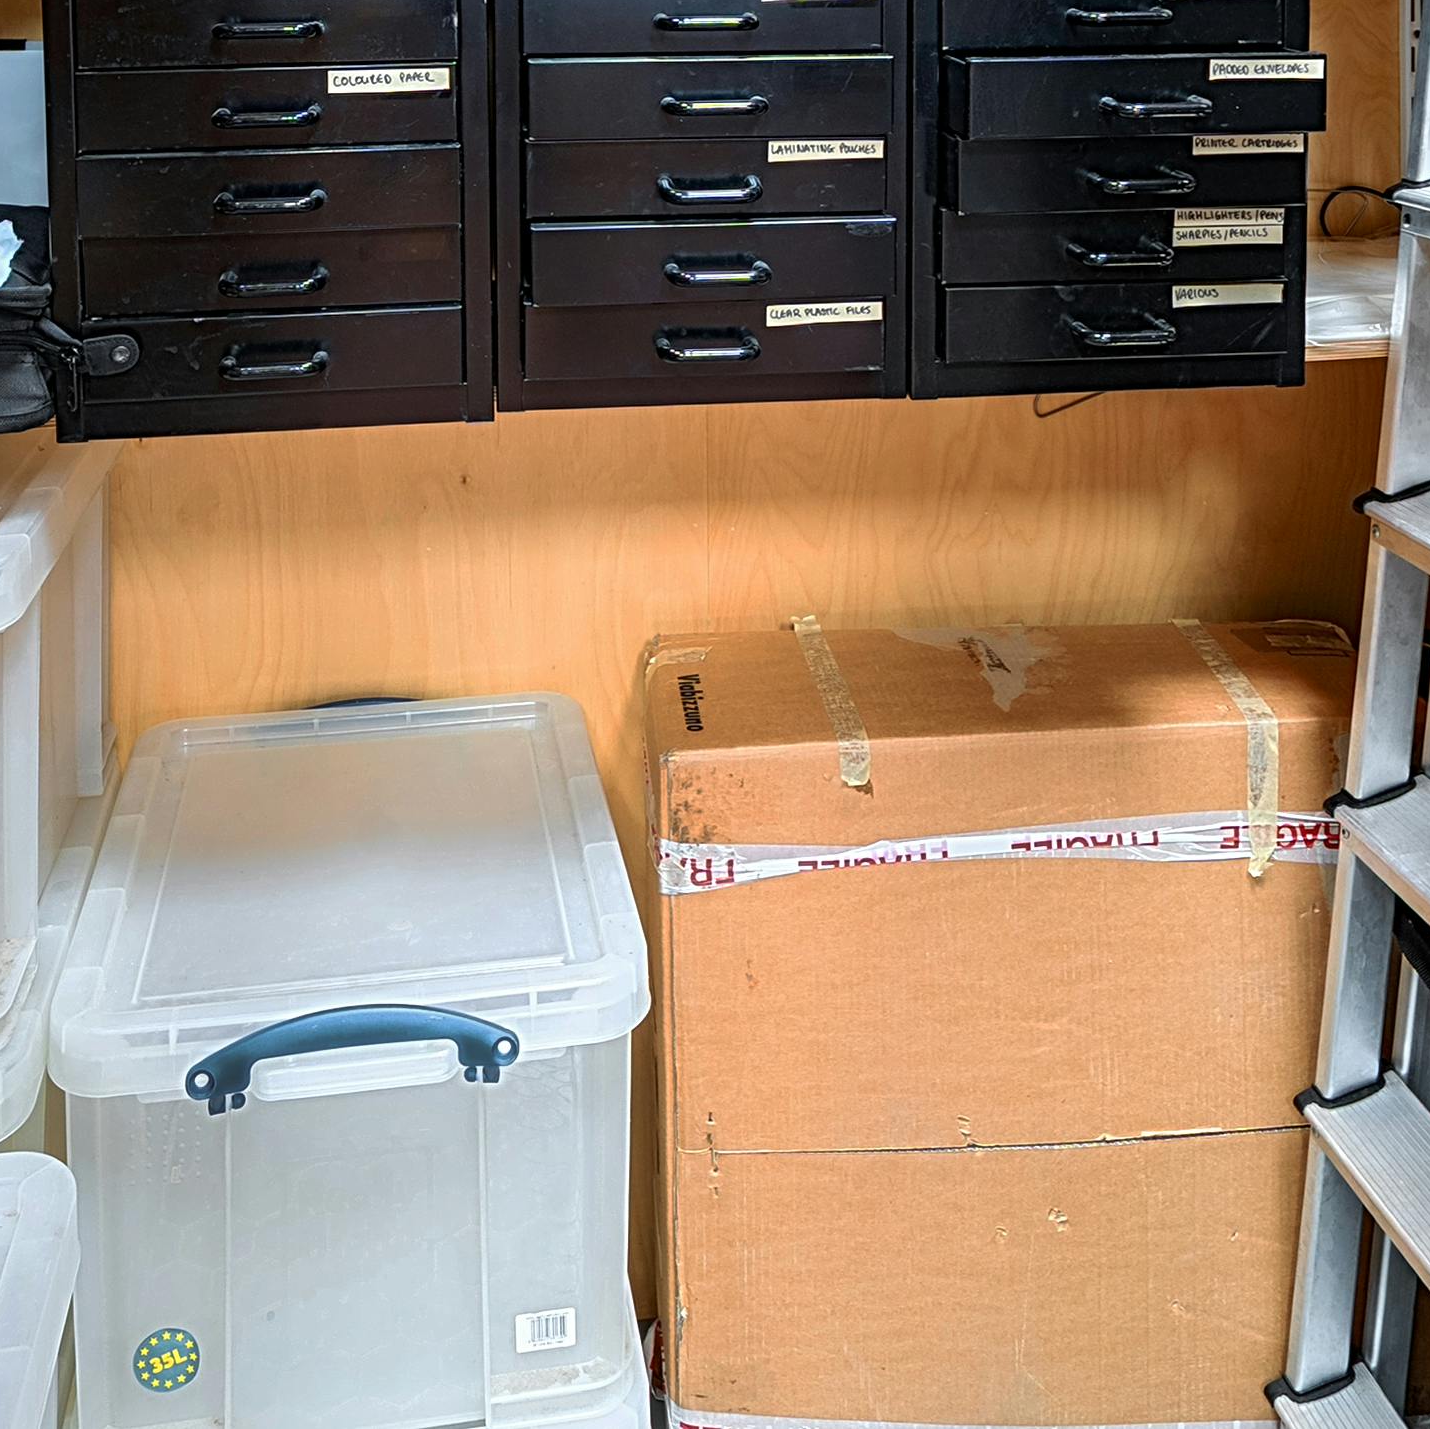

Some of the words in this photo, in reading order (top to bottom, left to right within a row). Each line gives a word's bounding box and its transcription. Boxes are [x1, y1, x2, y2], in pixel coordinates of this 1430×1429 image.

[1253, 62, 1310, 75] ENVELOPES
[332, 73, 393, 87] COLOURED
[398, 71, 436, 83] PAPER
[1194, 136, 1239, 149] PRINTER
[1174, 288, 1220, 302] VARIOUS
[769, 308, 802, 320] CLEAR
[803, 306, 841, 318] PLASTIC
[844, 305, 872, 316] FILES
[676, 673, 705, 733] Viabizzuno
[148, 1347, 189, 1375] 35L
